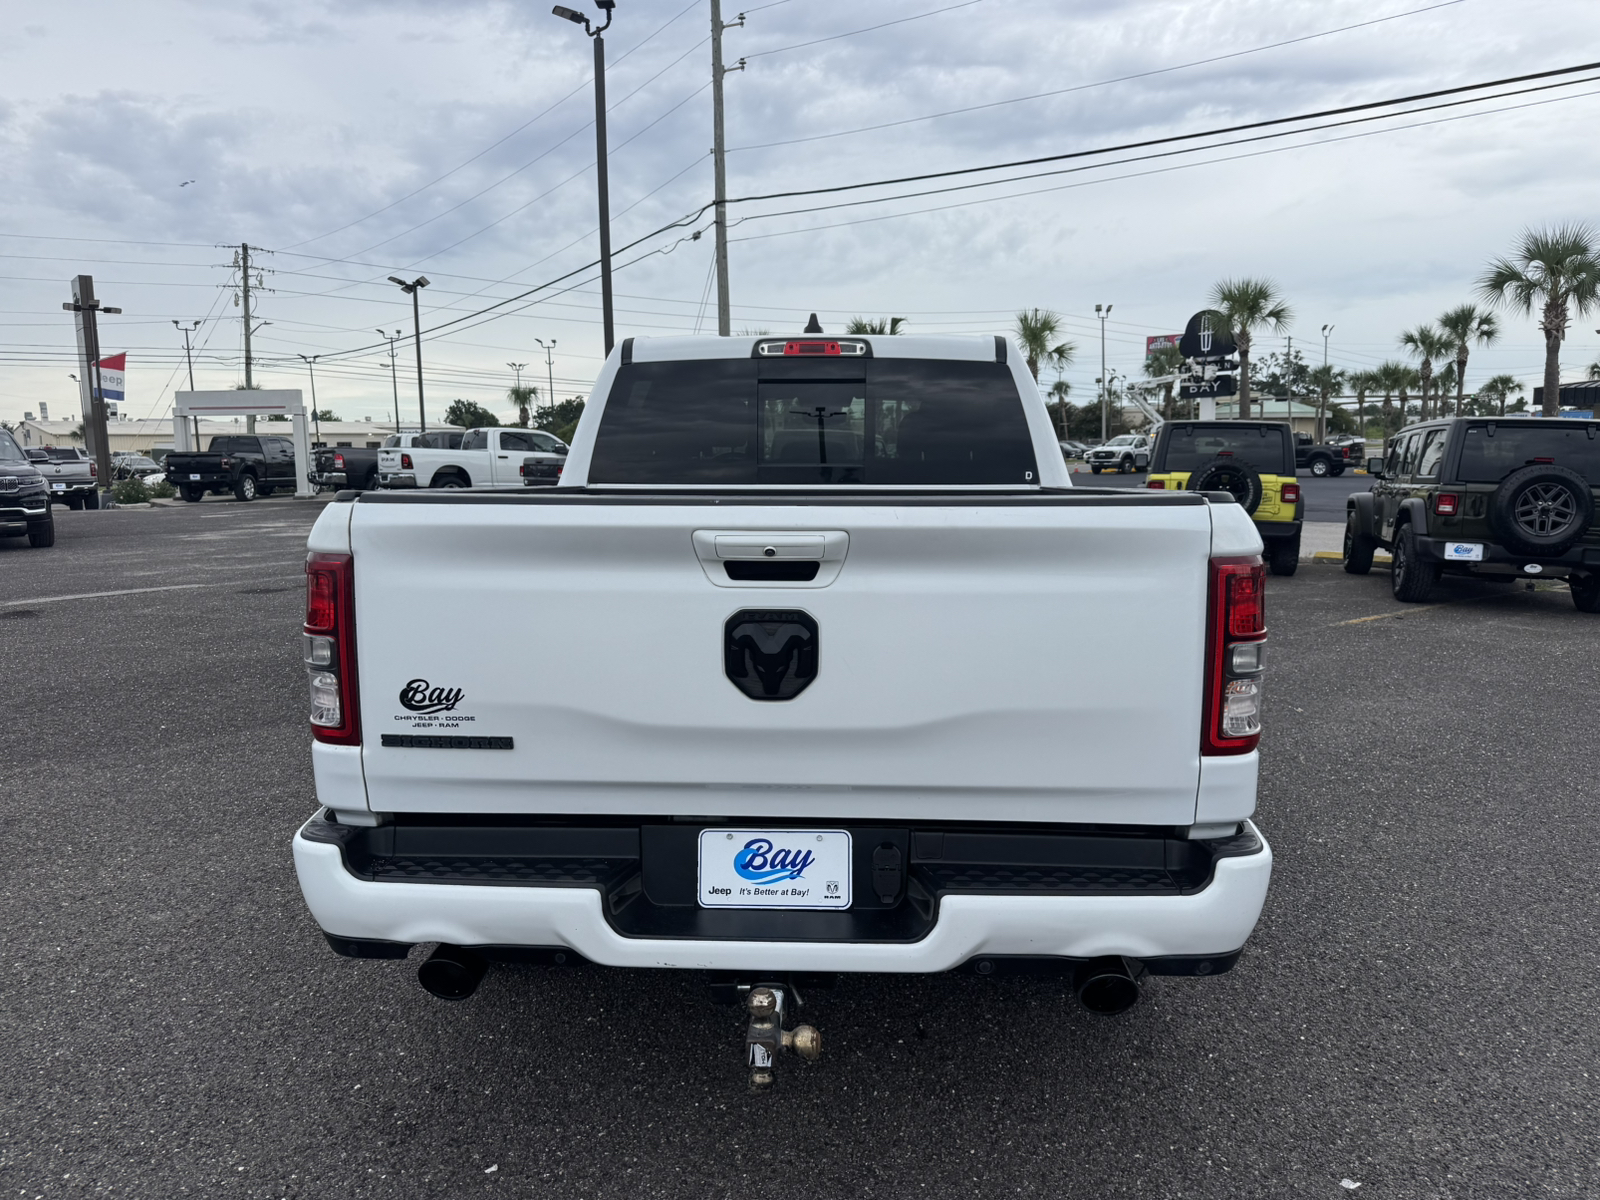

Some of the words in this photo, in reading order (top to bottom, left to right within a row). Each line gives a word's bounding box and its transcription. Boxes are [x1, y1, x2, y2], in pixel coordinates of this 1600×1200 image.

[101, 374, 123, 387] eep
[1025, 471, 1033, 480] D
[1454, 544, 1474, 554] Bay
[742, 611, 799, 621] RAM
[404, 679, 465, 711] Bay
[738, 838, 816, 880] Bay
[708, 886, 732, 896] Jeep
[739, 887, 752, 895] It's
[754, 888, 779, 896] Better
[791, 889, 810, 897] Bay!
